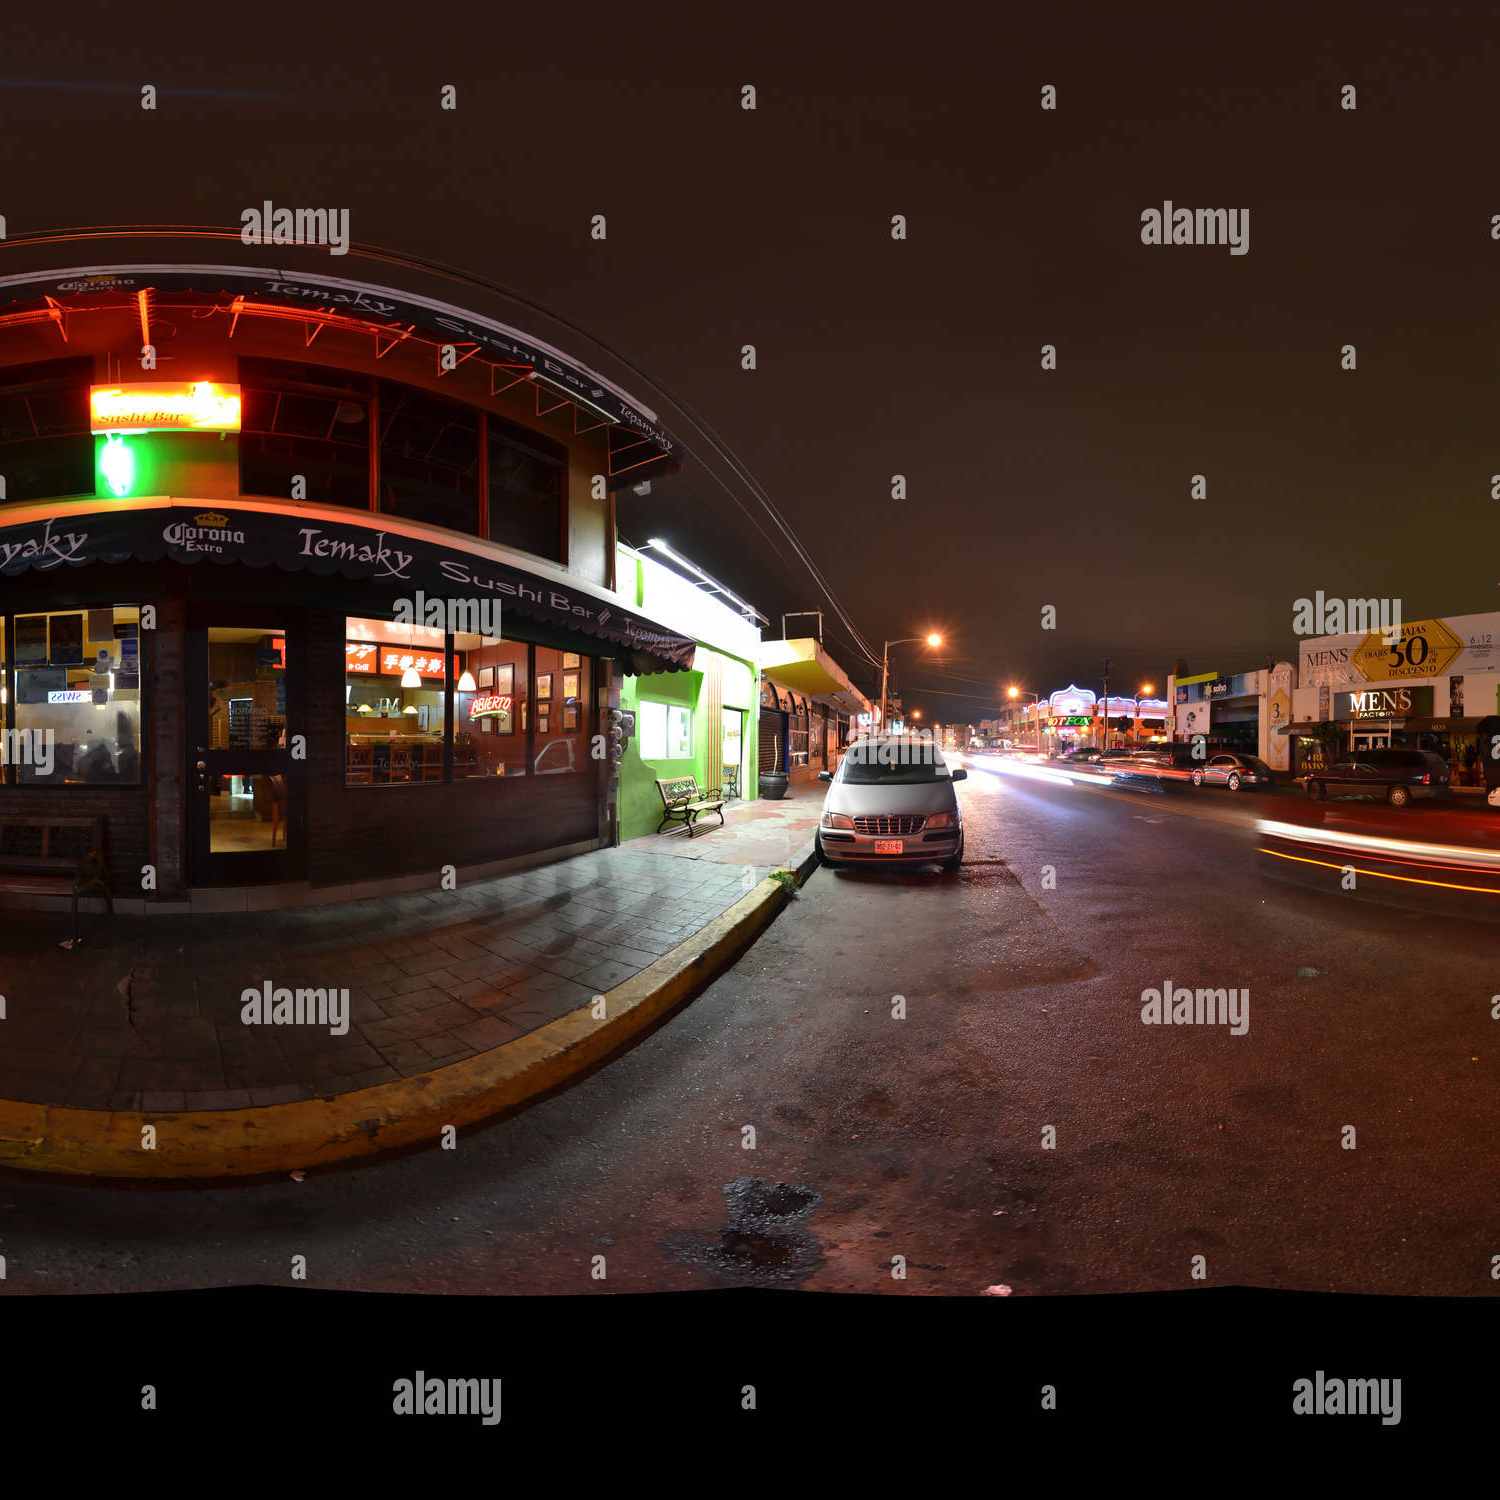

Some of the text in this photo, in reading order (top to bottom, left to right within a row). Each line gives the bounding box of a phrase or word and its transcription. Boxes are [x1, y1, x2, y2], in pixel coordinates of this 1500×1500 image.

[264, 281, 396, 317] Temaky
[435, 316, 538, 364] Sushi
[543, 357, 590, 388] Bar
[99, 412, 146, 424] Sushi
[152, 412, 184, 422] Bar
[163, 521, 246, 546] Corona
[186, 541, 223, 554] Extra
[298, 528, 414, 579] Temaky
[438, 559, 543, 604] Sushi
[548, 591, 595, 621] Bar
[1388, 625, 1427, 637] REBAJAS
[1482, 633, 1492, 643] 12
[1388, 635, 1429, 668] 50
[355, 663, 370, 671] Grill
[383, 653, 445, 674] 手巻き寿
[1388, 665, 1437, 677] DESCUENTO
[470, 695, 513, 716] ABIERTO
[1359, 710, 1397, 719] FACTORY
